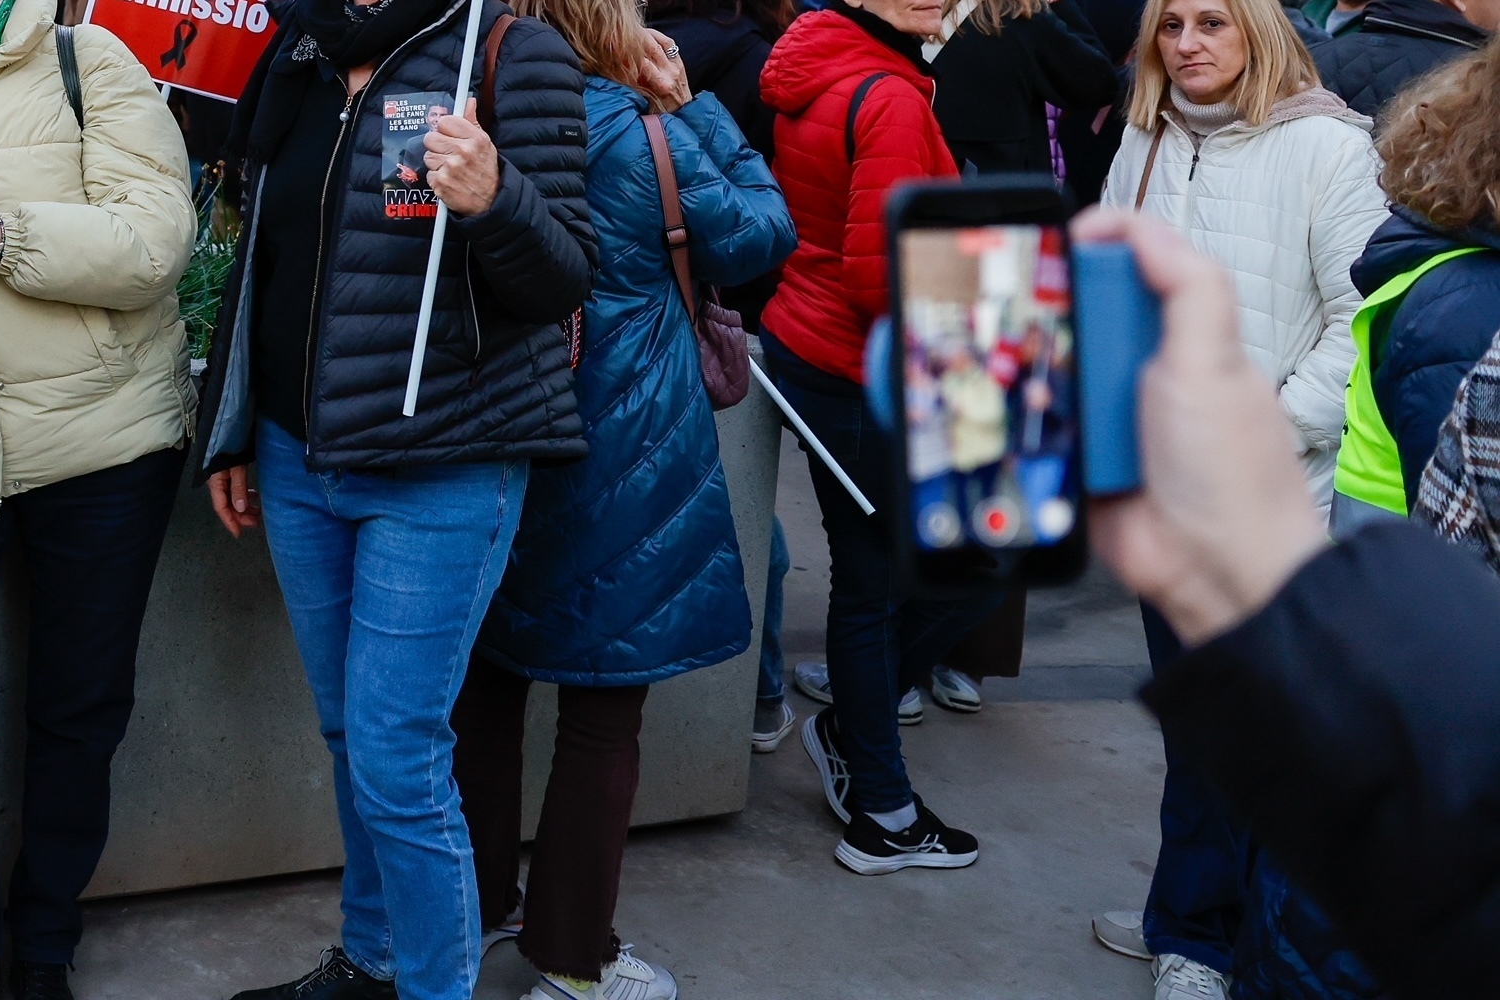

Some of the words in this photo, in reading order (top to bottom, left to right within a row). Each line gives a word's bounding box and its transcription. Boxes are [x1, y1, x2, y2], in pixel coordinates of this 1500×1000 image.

[396, 104, 427, 112] NOSTRES
[407, 110, 425, 118] FANG
[403, 117, 425, 125] SEUES
